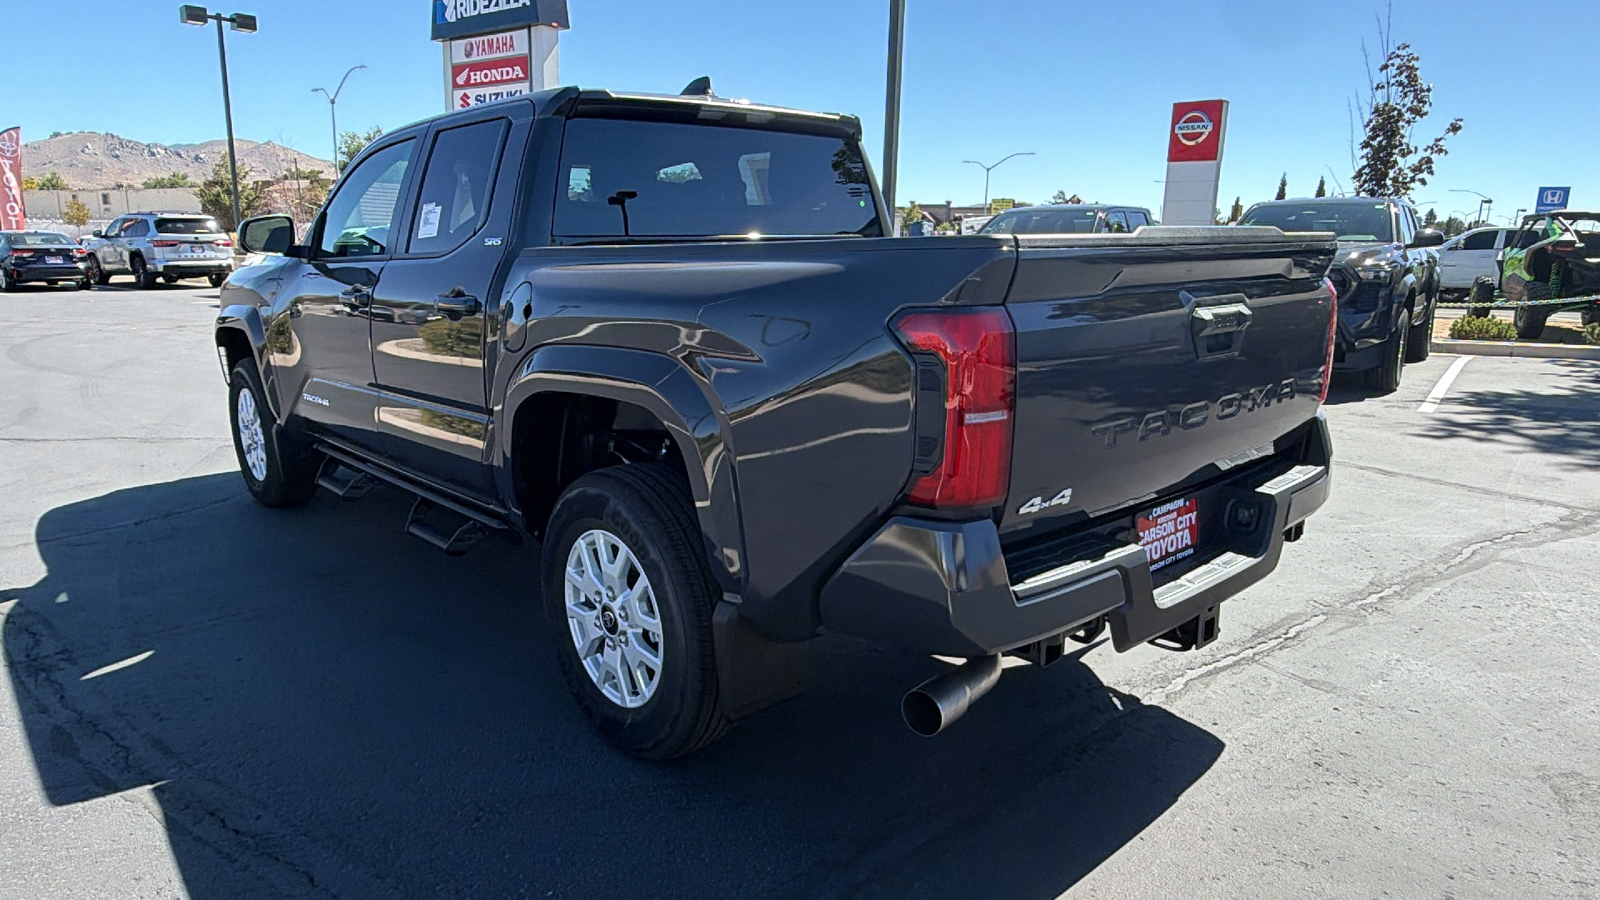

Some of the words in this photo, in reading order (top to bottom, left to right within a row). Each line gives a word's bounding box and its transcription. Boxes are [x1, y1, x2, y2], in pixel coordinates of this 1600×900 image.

[475, 35, 515, 57] YAMAHA
[469, 66, 525, 84] HONDA
[484, 237, 502, 246] SR5
[302, 392, 330, 407] TACOMA
[1091, 377, 1297, 450] TACOMA
[1152, 498, 1184, 517] CAMPAGNI
[1177, 511, 1197, 530] CITY
[1144, 528, 1191, 562] TOYOTA
[1149, 560, 1166, 572] ARSON
[1165, 555, 1176, 565] CITY
[1177, 548, 1194, 560] TOYOTA
